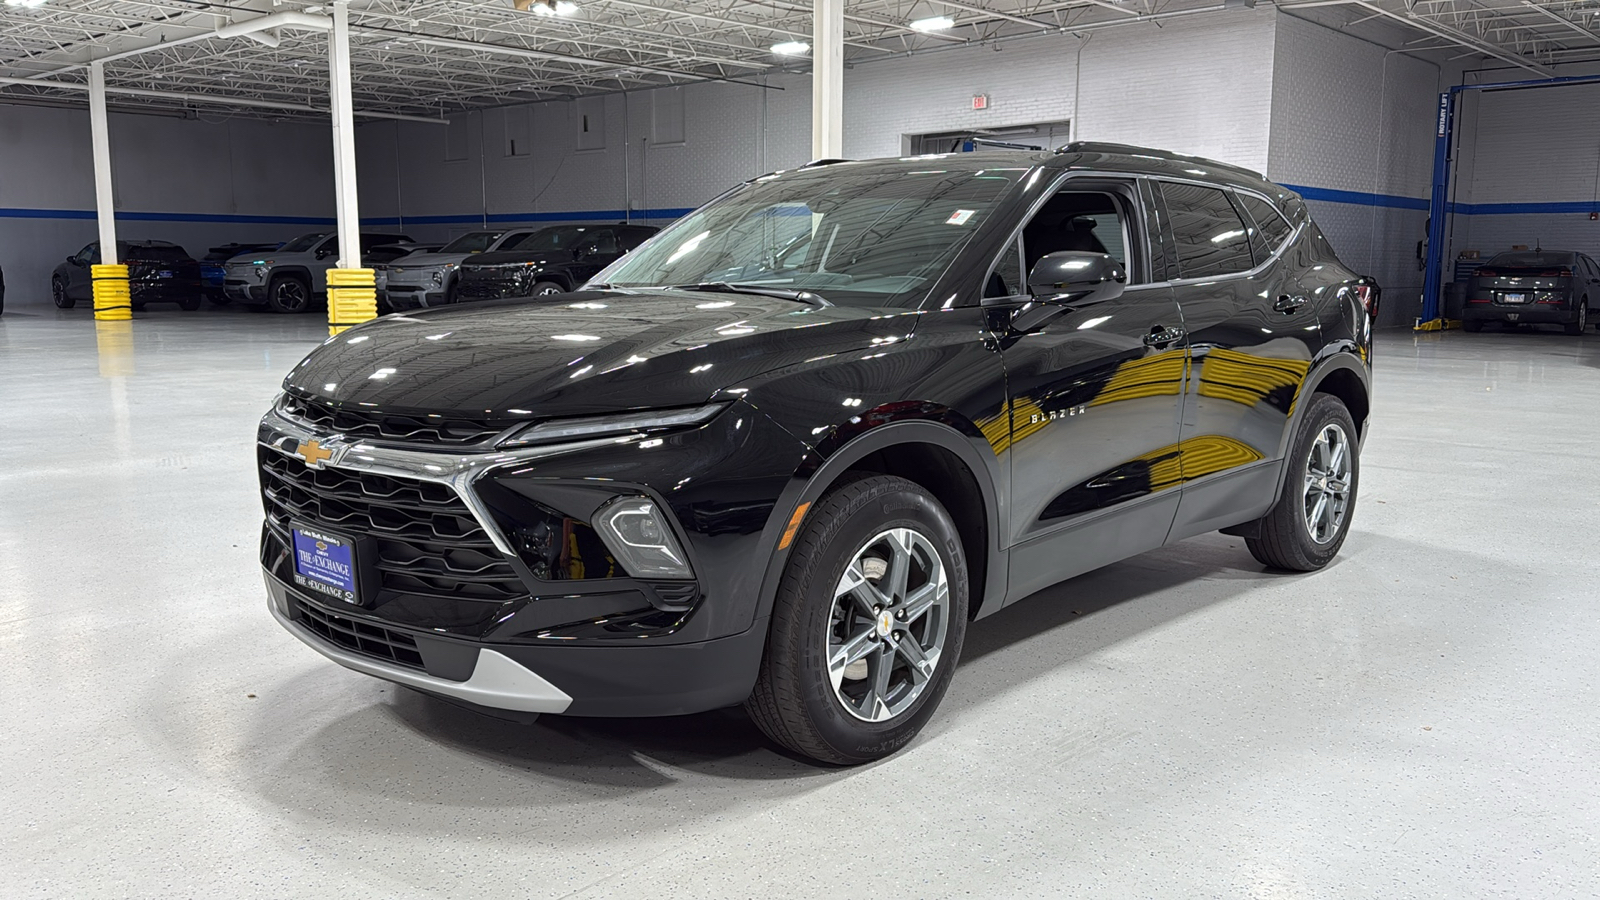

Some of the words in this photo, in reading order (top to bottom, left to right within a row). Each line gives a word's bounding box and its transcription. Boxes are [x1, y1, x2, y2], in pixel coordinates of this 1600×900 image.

[1438, 108, 1446, 134] ROTARY
[1031, 405, 1085, 424] BLAZER
[298, 549, 313, 564] THE
[314, 554, 351, 577] EXCHANGE
[294, 574, 307, 586] THE
[311, 580, 342, 598] EXCHANGE
[856, 745, 879, 753] SPORT
